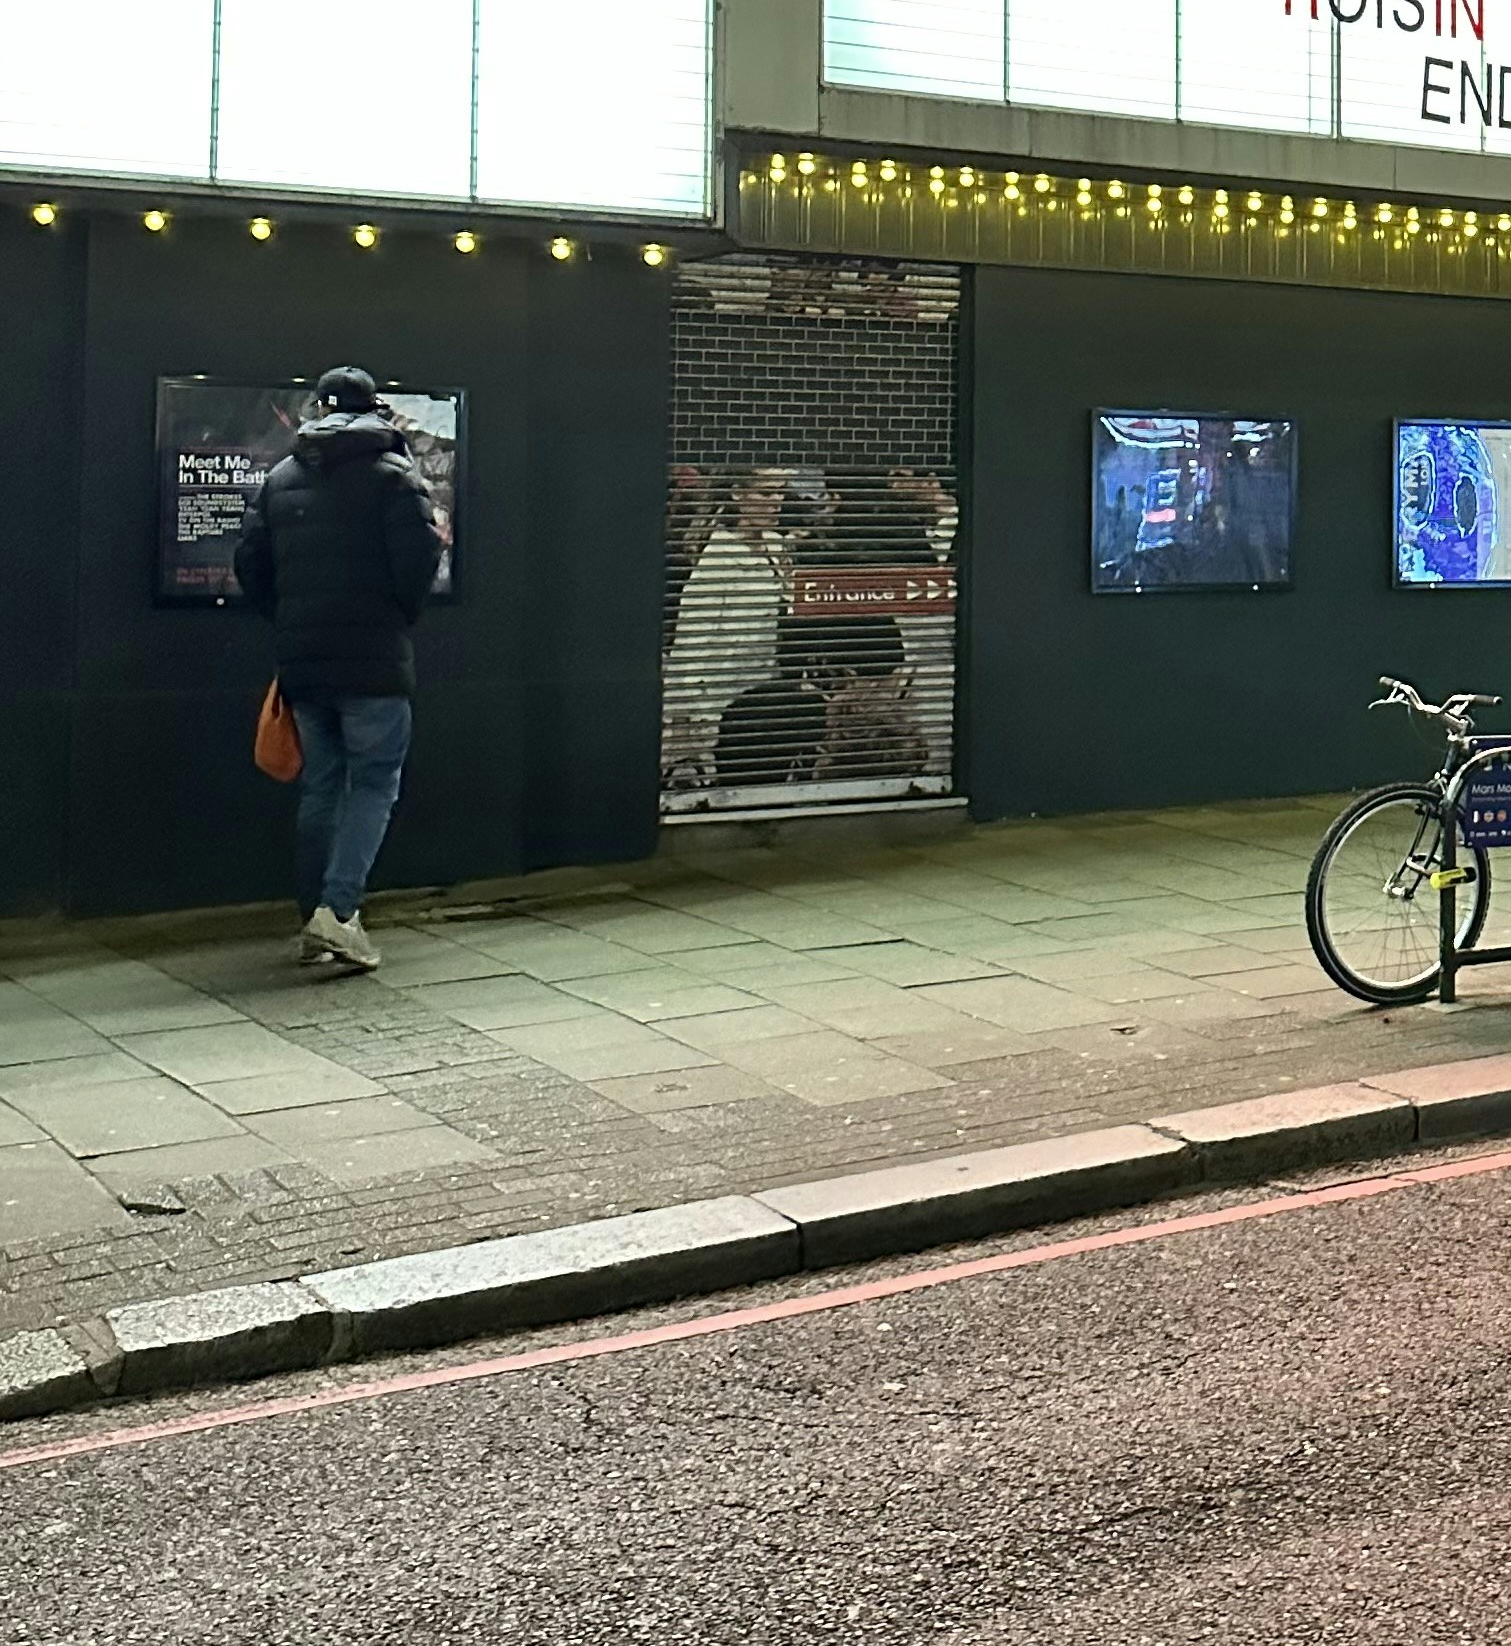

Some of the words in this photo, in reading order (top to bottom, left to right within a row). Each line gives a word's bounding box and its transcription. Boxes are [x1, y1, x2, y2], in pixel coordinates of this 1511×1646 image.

[179, 454, 220, 469] Meet
[225, 455, 251, 469] Me
[179, 469, 194, 484] In
[197, 470, 229, 484] The
[804, 581, 896, 602] Entrance
[1471, 784, 1495, 794] Mars
